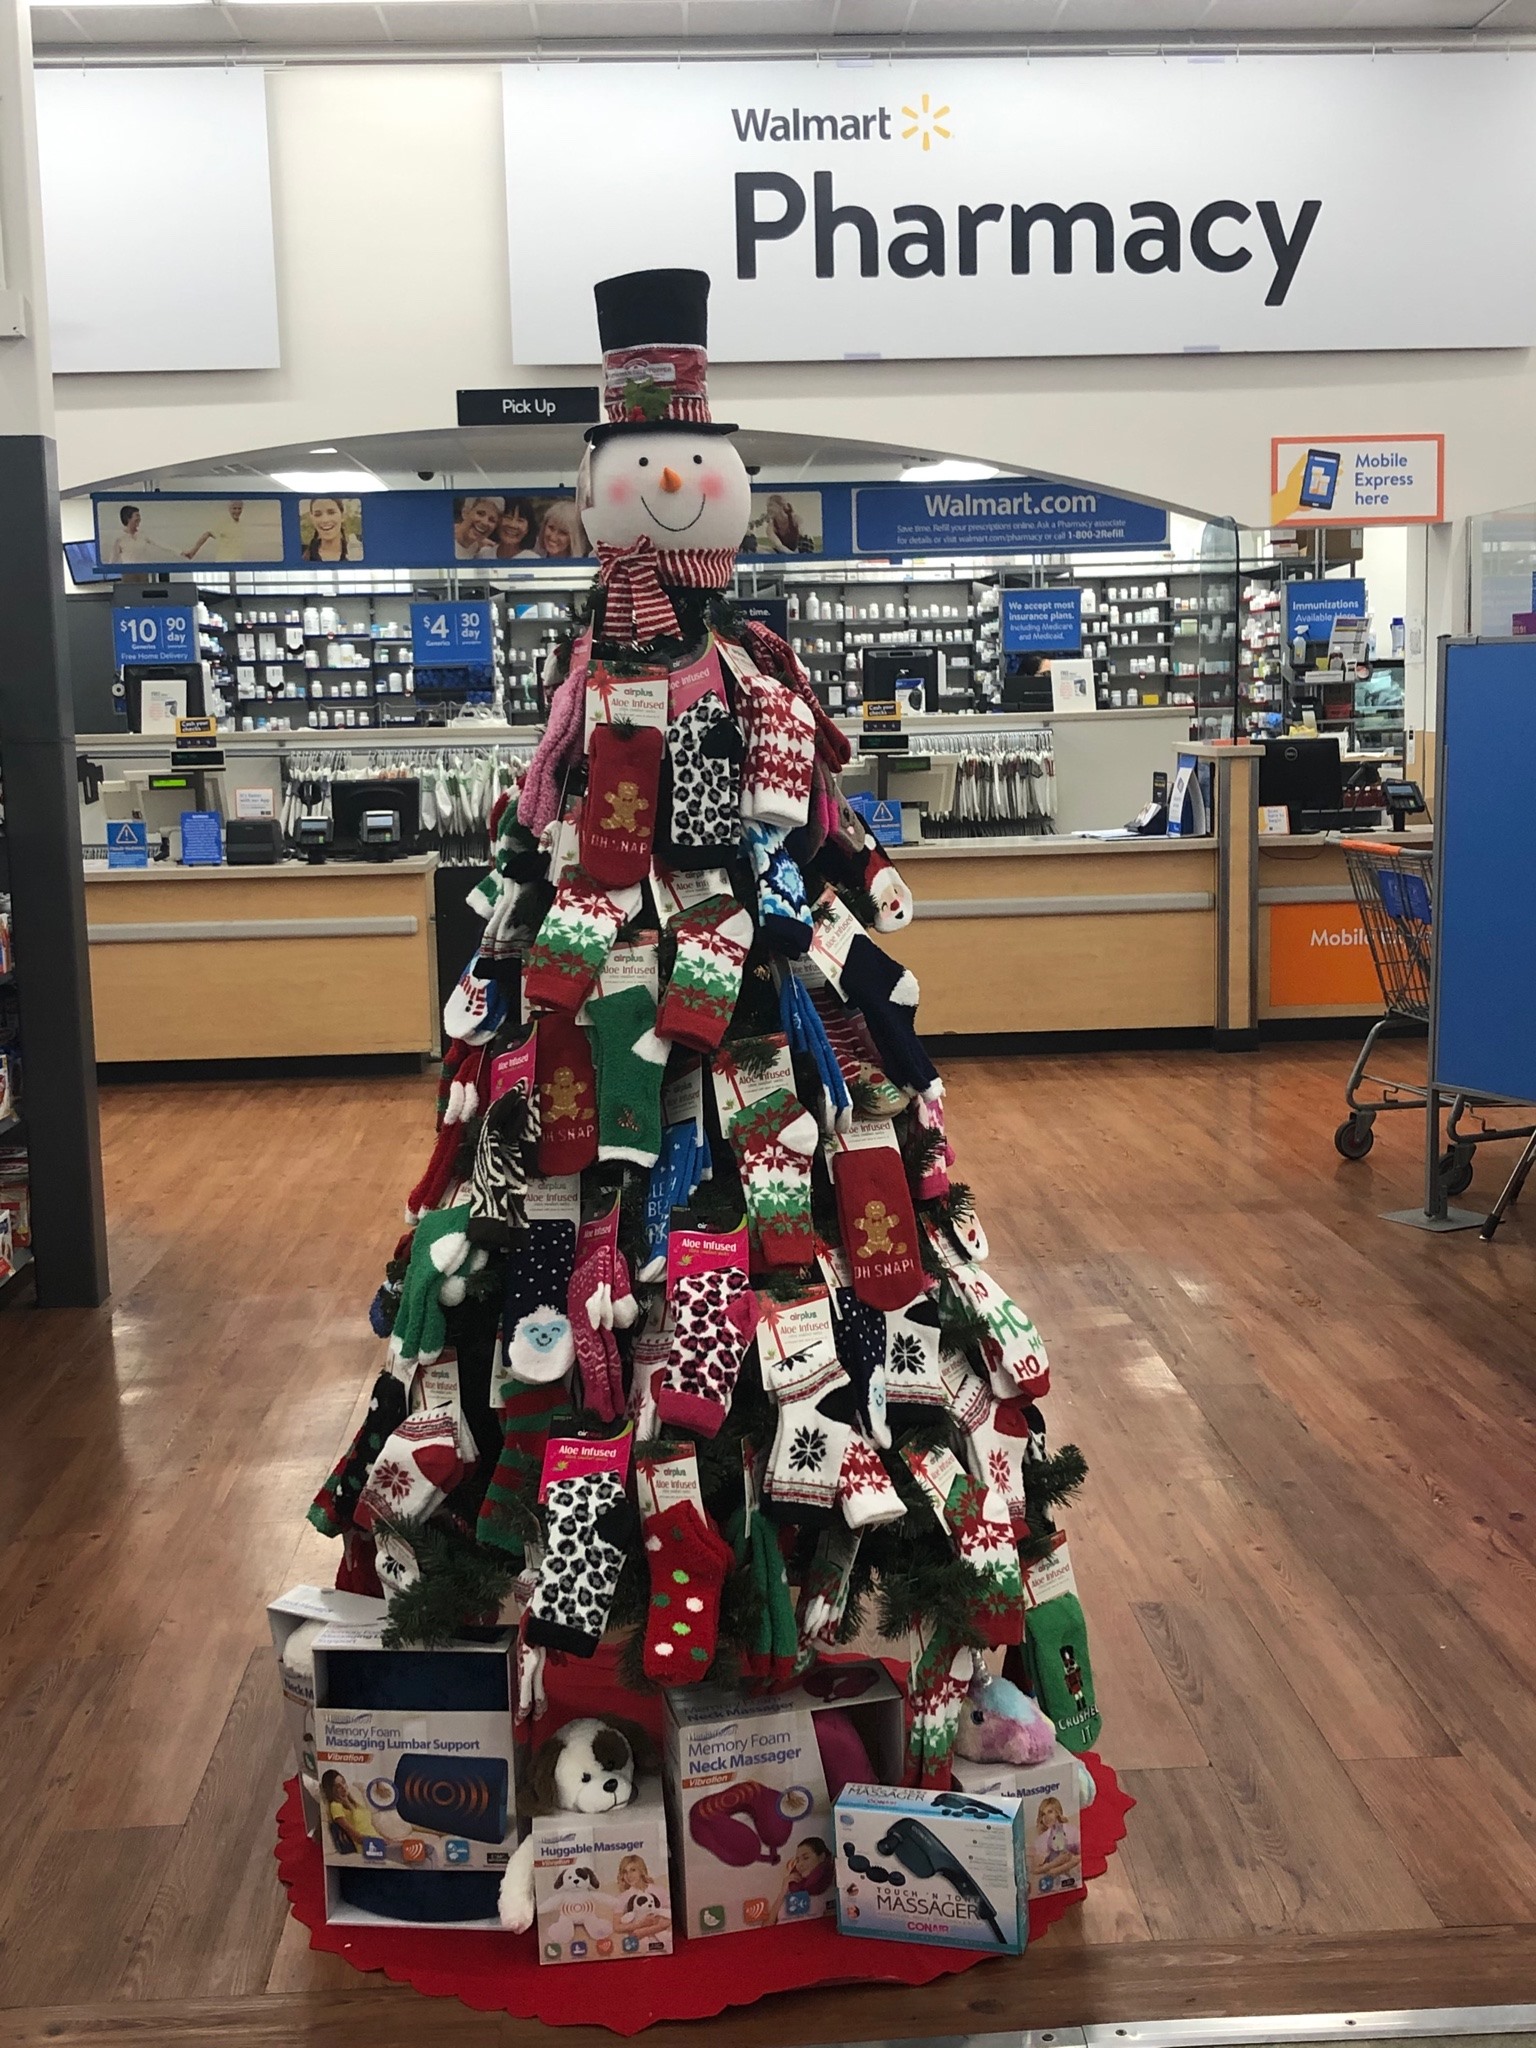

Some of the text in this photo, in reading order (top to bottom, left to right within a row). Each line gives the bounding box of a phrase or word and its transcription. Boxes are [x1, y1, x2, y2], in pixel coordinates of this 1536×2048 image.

[731, 107, 892, 142] Walmart
[734, 170, 1323, 307] Pharmacy
[502, 399, 556, 416] Pick Up
[1355, 453, 1408, 468] Mobile
[1354, 472, 1414, 490] Express
[924, 491, 1098, 518] Walmart.com
[1355, 491, 1389, 505] here
[897, 525, 913, 533] Save
[1057, 520, 1092, 530] Pharmacy
[749, 607, 771, 616] time.
[1008, 601, 1075, 612] We accept most
[1292, 600, 1359, 611] Immunizations
[461, 612, 480, 627] 30
[1008, 612, 1048, 621] insurance
[1295, 612, 1332, 622] Available
[120, 618, 157, 643] $10
[166, 617, 186, 631] 90
[423, 614, 450, 639] $4
[1042, 623, 1073, 631] Medicare
[167, 632, 186, 644] day
[461, 628, 480, 640] day
[160, 652, 188, 660] Delivery
[681, 668, 710, 685] Infused
[624, 688, 653, 698] airplus
[611, 697, 665, 709] Aloe Infused
[613, 953, 643, 964] airplus
[622, 965, 656, 974] Infused
[861, 1122, 890, 1133] Infused
[546, 1192, 578, 1202] Infused
[681, 1239, 737, 1252] Aloe Infused
[790, 1311, 817, 1321] airplus
[780, 1321, 830, 1335] Aloe Infused
[987, 1300, 1033, 1346] HO
[1013, 1354, 1041, 1379] HO
[558, 1445, 579, 1455] Aloe
[581, 1446, 617, 1458] Infused
[663, 1466, 686, 1477] airplus
[655, 1480, 697, 1489] Aloe Infused
[1046, 1563, 1070, 1581] Infused
[325, 1725, 400, 1738] Memory Foam
[1081, 1724, 1094, 1744] IT
[326, 1736, 480, 1751] Massaging Lumbar Support
[688, 1732, 791, 1757] Memory Foam
[327, 1752, 365, 1762] Vibration
[689, 1748, 802, 1775] Neck Massager
[689, 1775, 728, 1787] Vibration
[1016, 1782, 1060, 1798] Massager
[541, 1840, 644, 1858] Huggable Massager
[876, 1886, 918, 1897] TOUCH
[876, 1895, 981, 1920] MASSAGER
[907, 1921, 950, 1933] CONAIR
